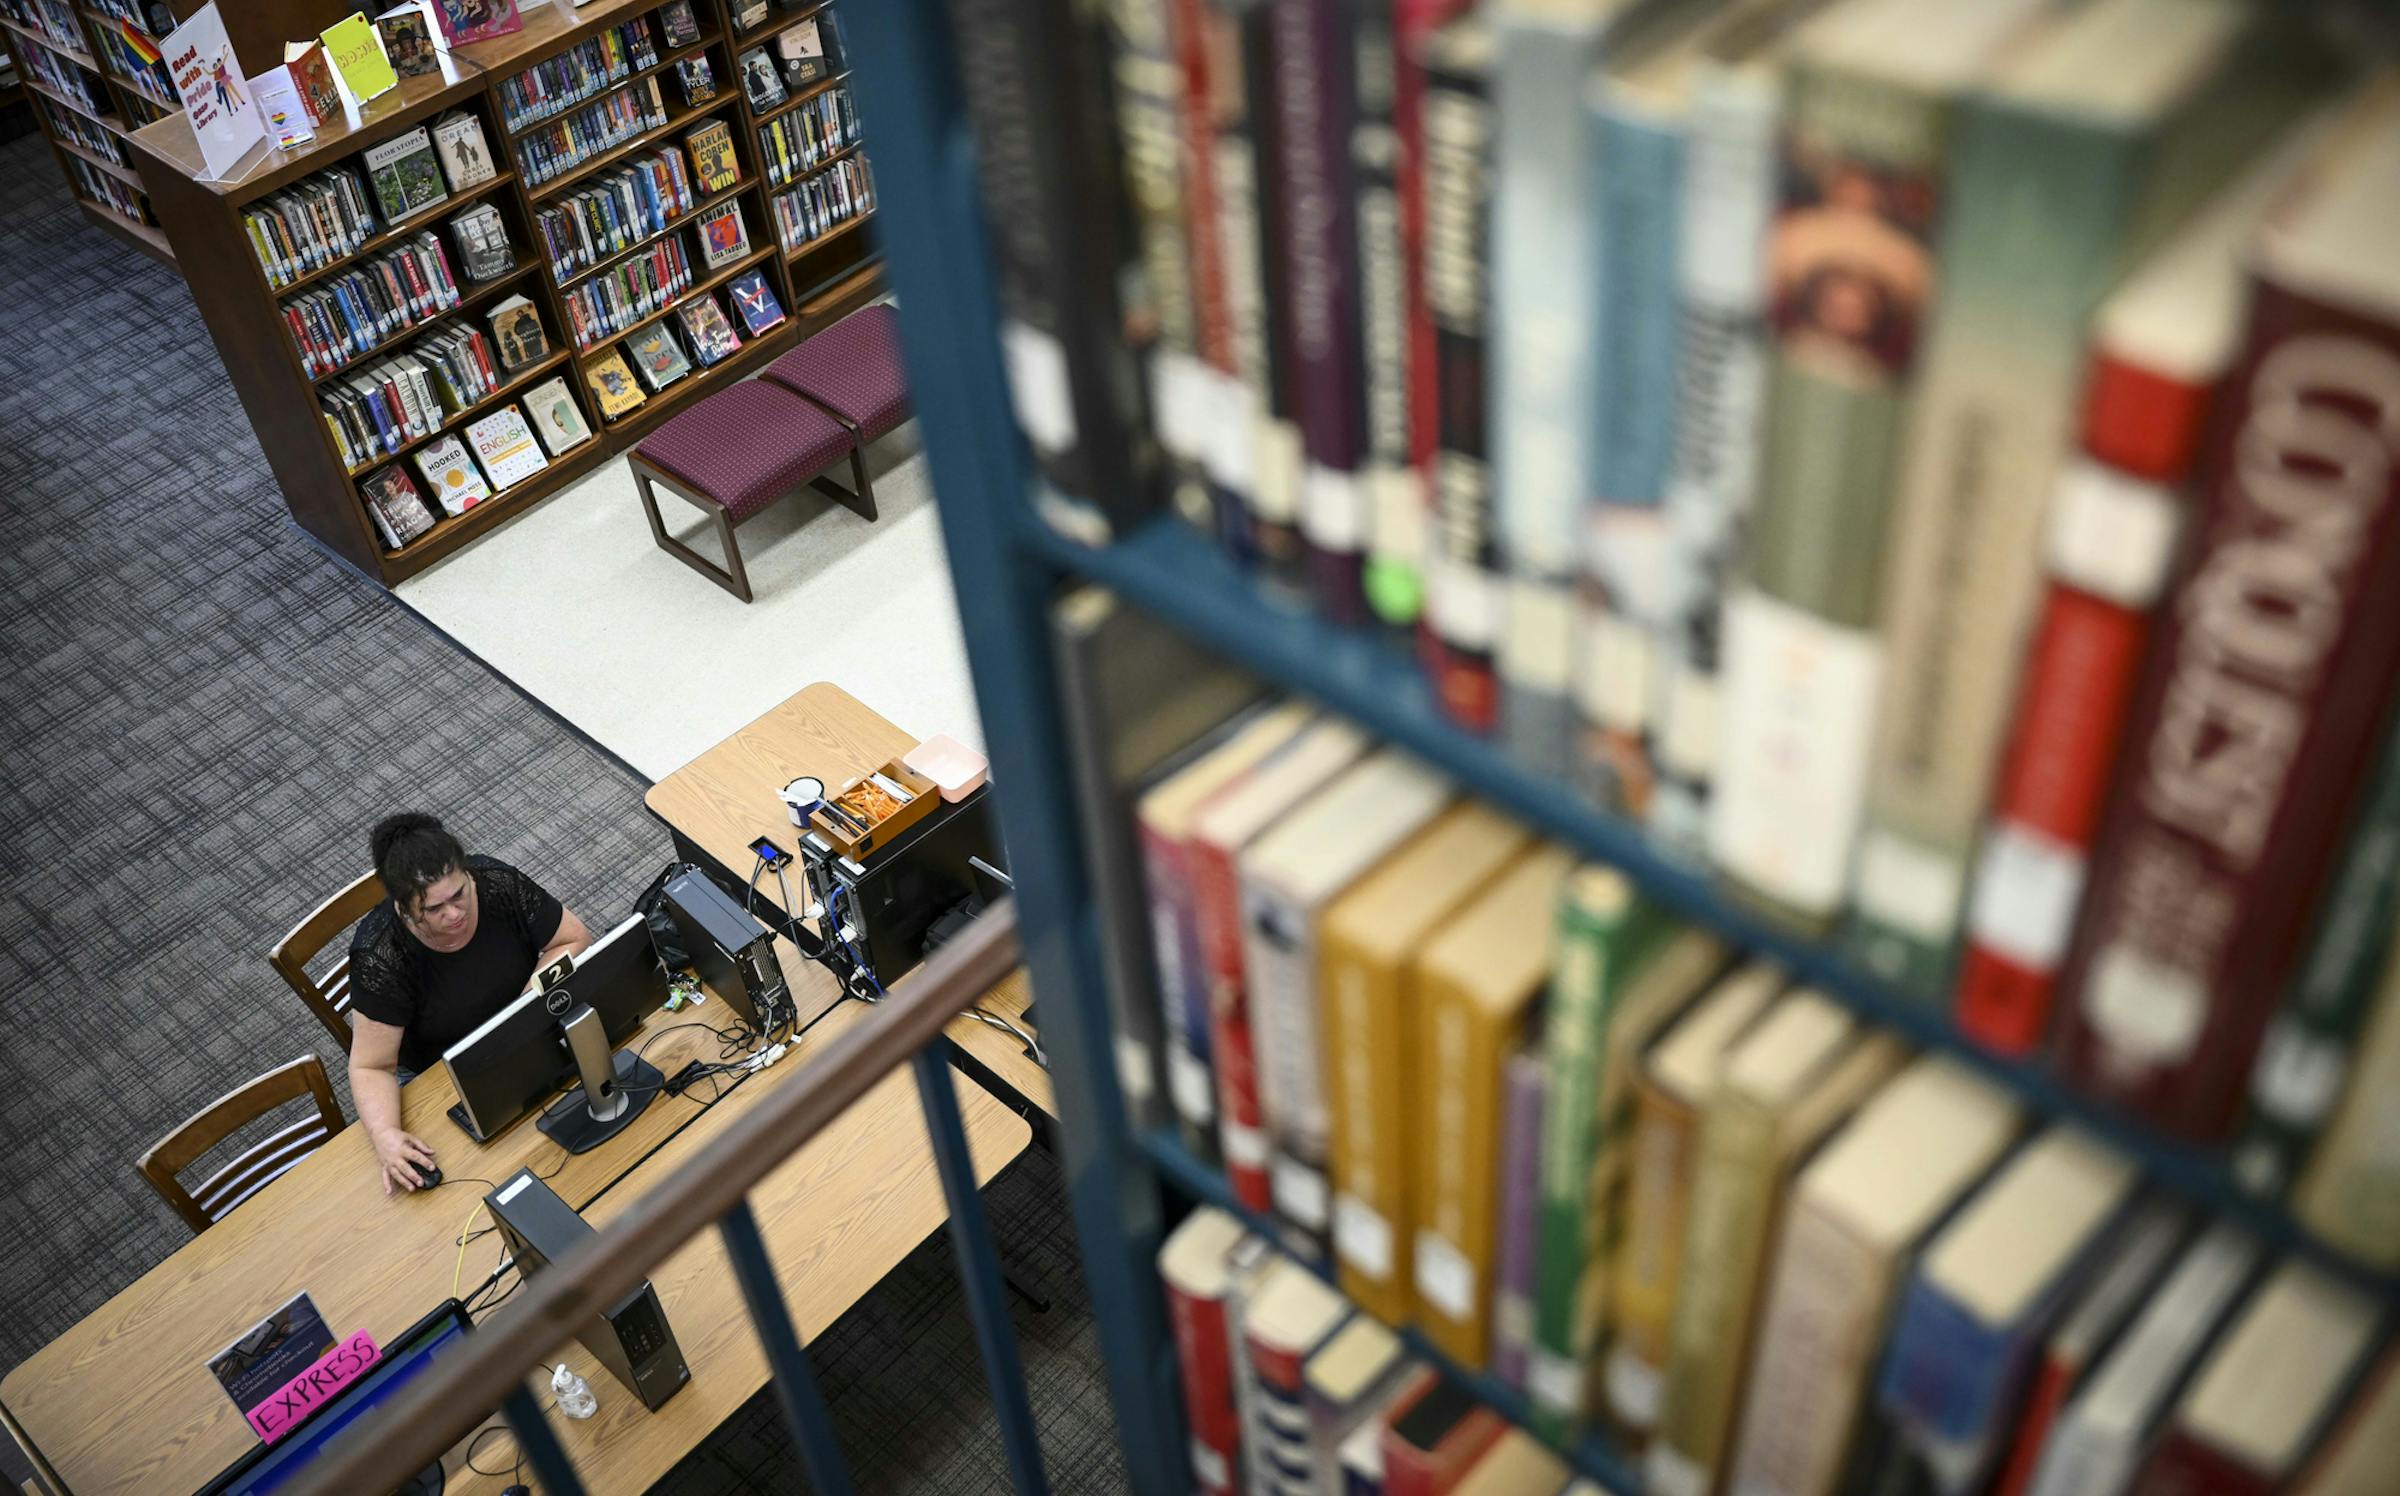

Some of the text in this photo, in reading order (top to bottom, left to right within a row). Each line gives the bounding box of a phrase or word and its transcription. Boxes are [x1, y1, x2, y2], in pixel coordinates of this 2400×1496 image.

[172, 44, 197, 73] Read
[179, 66, 202, 90] with
[314, 85, 338, 112] FELIX
[196, 108, 218, 130] Library
[441, 124, 479, 142] DREAM
[375, 135, 424, 161] FLORATOPIA
[708, 169, 736, 192] WIN
[700, 202, 737, 225] ANIMAL
[479, 258, 505, 271] Tammy
[710, 251, 724, 262] LISA
[473, 261, 515, 280] Duckworth
[398, 379, 418, 416] CALHOUN
[480, 425, 527, 455] ENGLISH
[427, 449, 461, 472] HOOKED
[447, 490, 467, 503] MICHAEL
[395, 511, 430, 535] REAGAN
[548, 964, 565, 984] 2
[550, 994, 569, 1011] DELL
[281, 1341, 315, 1367] checkout
[240, 1351, 291, 1391] Chromebooks
[255, 1337, 375, 1433] EXPRESS
